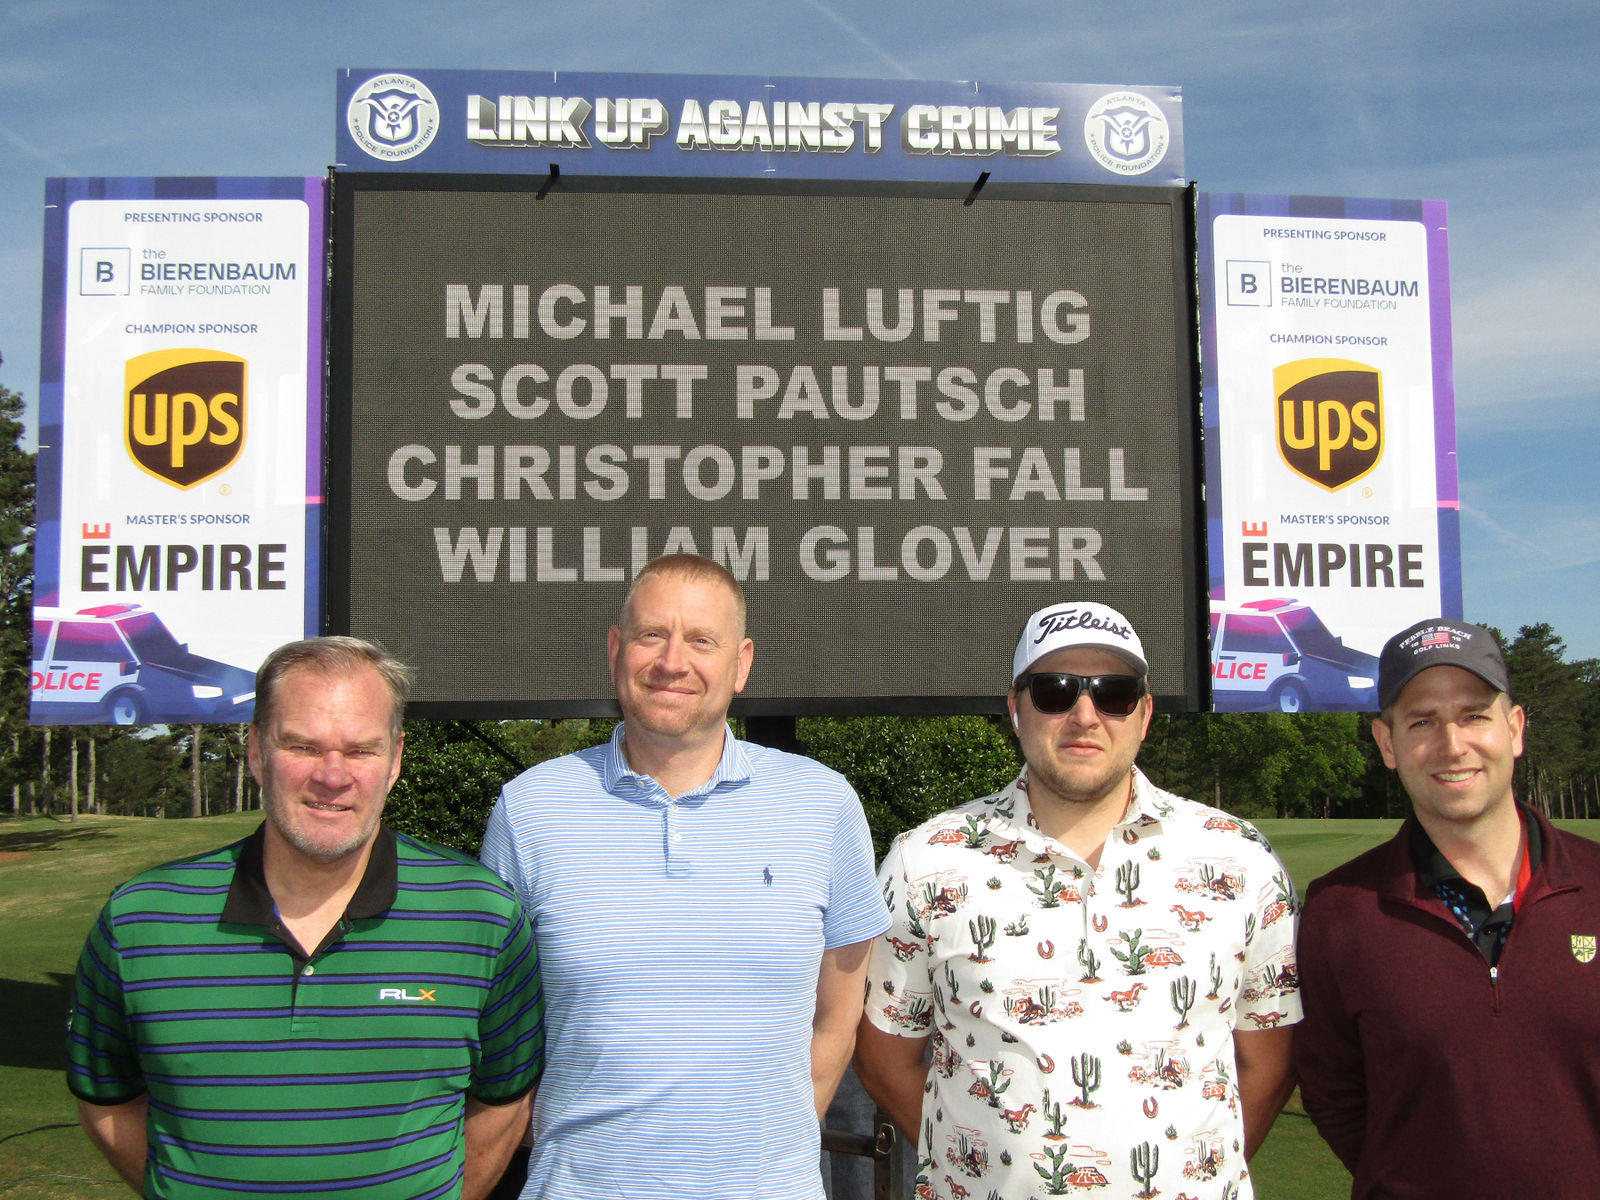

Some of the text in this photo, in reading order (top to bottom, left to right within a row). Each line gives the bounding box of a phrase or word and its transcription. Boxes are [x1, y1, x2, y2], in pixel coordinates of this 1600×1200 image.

[373, 78, 416, 89] ATLANTA
[1106, 95, 1146, 107] ATLANTA
[467, 94, 1062, 158] LINK UP AGAINST CRIME
[353, 125, 434, 157] POLICE FOUNDATION
[1090, 139, 1165, 171] POLICE FOUNDATION
[124, 212, 263, 222] PRESENTING SPONSOR
[1263, 228, 1387, 241] PRESENTING SPONSOR
[142, 248, 167, 260] the
[96, 261, 114, 283] B
[141, 263, 297, 281] BIERENBAUM
[1281, 262, 1303, 273] the
[140, 285, 271, 296] FAMILY FOUNDATION
[1241, 273, 1258, 294] B
[1281, 276, 1419, 297] BIERENBAUM
[1281, 297, 1397, 310] FAMILY FOUNDATION
[446, 283, 1091, 344] MICHAEL LUFTIG
[125, 324, 258, 334] CHAMPION SPONSOR
[1270, 333, 1388, 346] CHAMPION SPONSOR
[449, 363, 1086, 422] SCOTT PAUTSCH
[133, 392, 240, 469] ups
[1282, 400, 1378, 471] ups
[387, 444, 1149, 502] CHRISTOPHER FALL
[126, 514, 250, 525] MASTER'S SPONSOR
[1280, 514, 1390, 525] MASTER'S SPONSOR
[799, 525, 1106, 582] GLOVER
[81, 543, 287, 592] EMPIRE
[1242, 542, 1424, 588] EMPIRE
[1034, 608, 1132, 645] Titleist
[1399, 626, 1472, 648] PEBBLE BEACH
[1413, 646, 1432, 655] GOLF
[1211, 662, 1268, 680] LICE
[380, 988, 437, 1001] RLX
